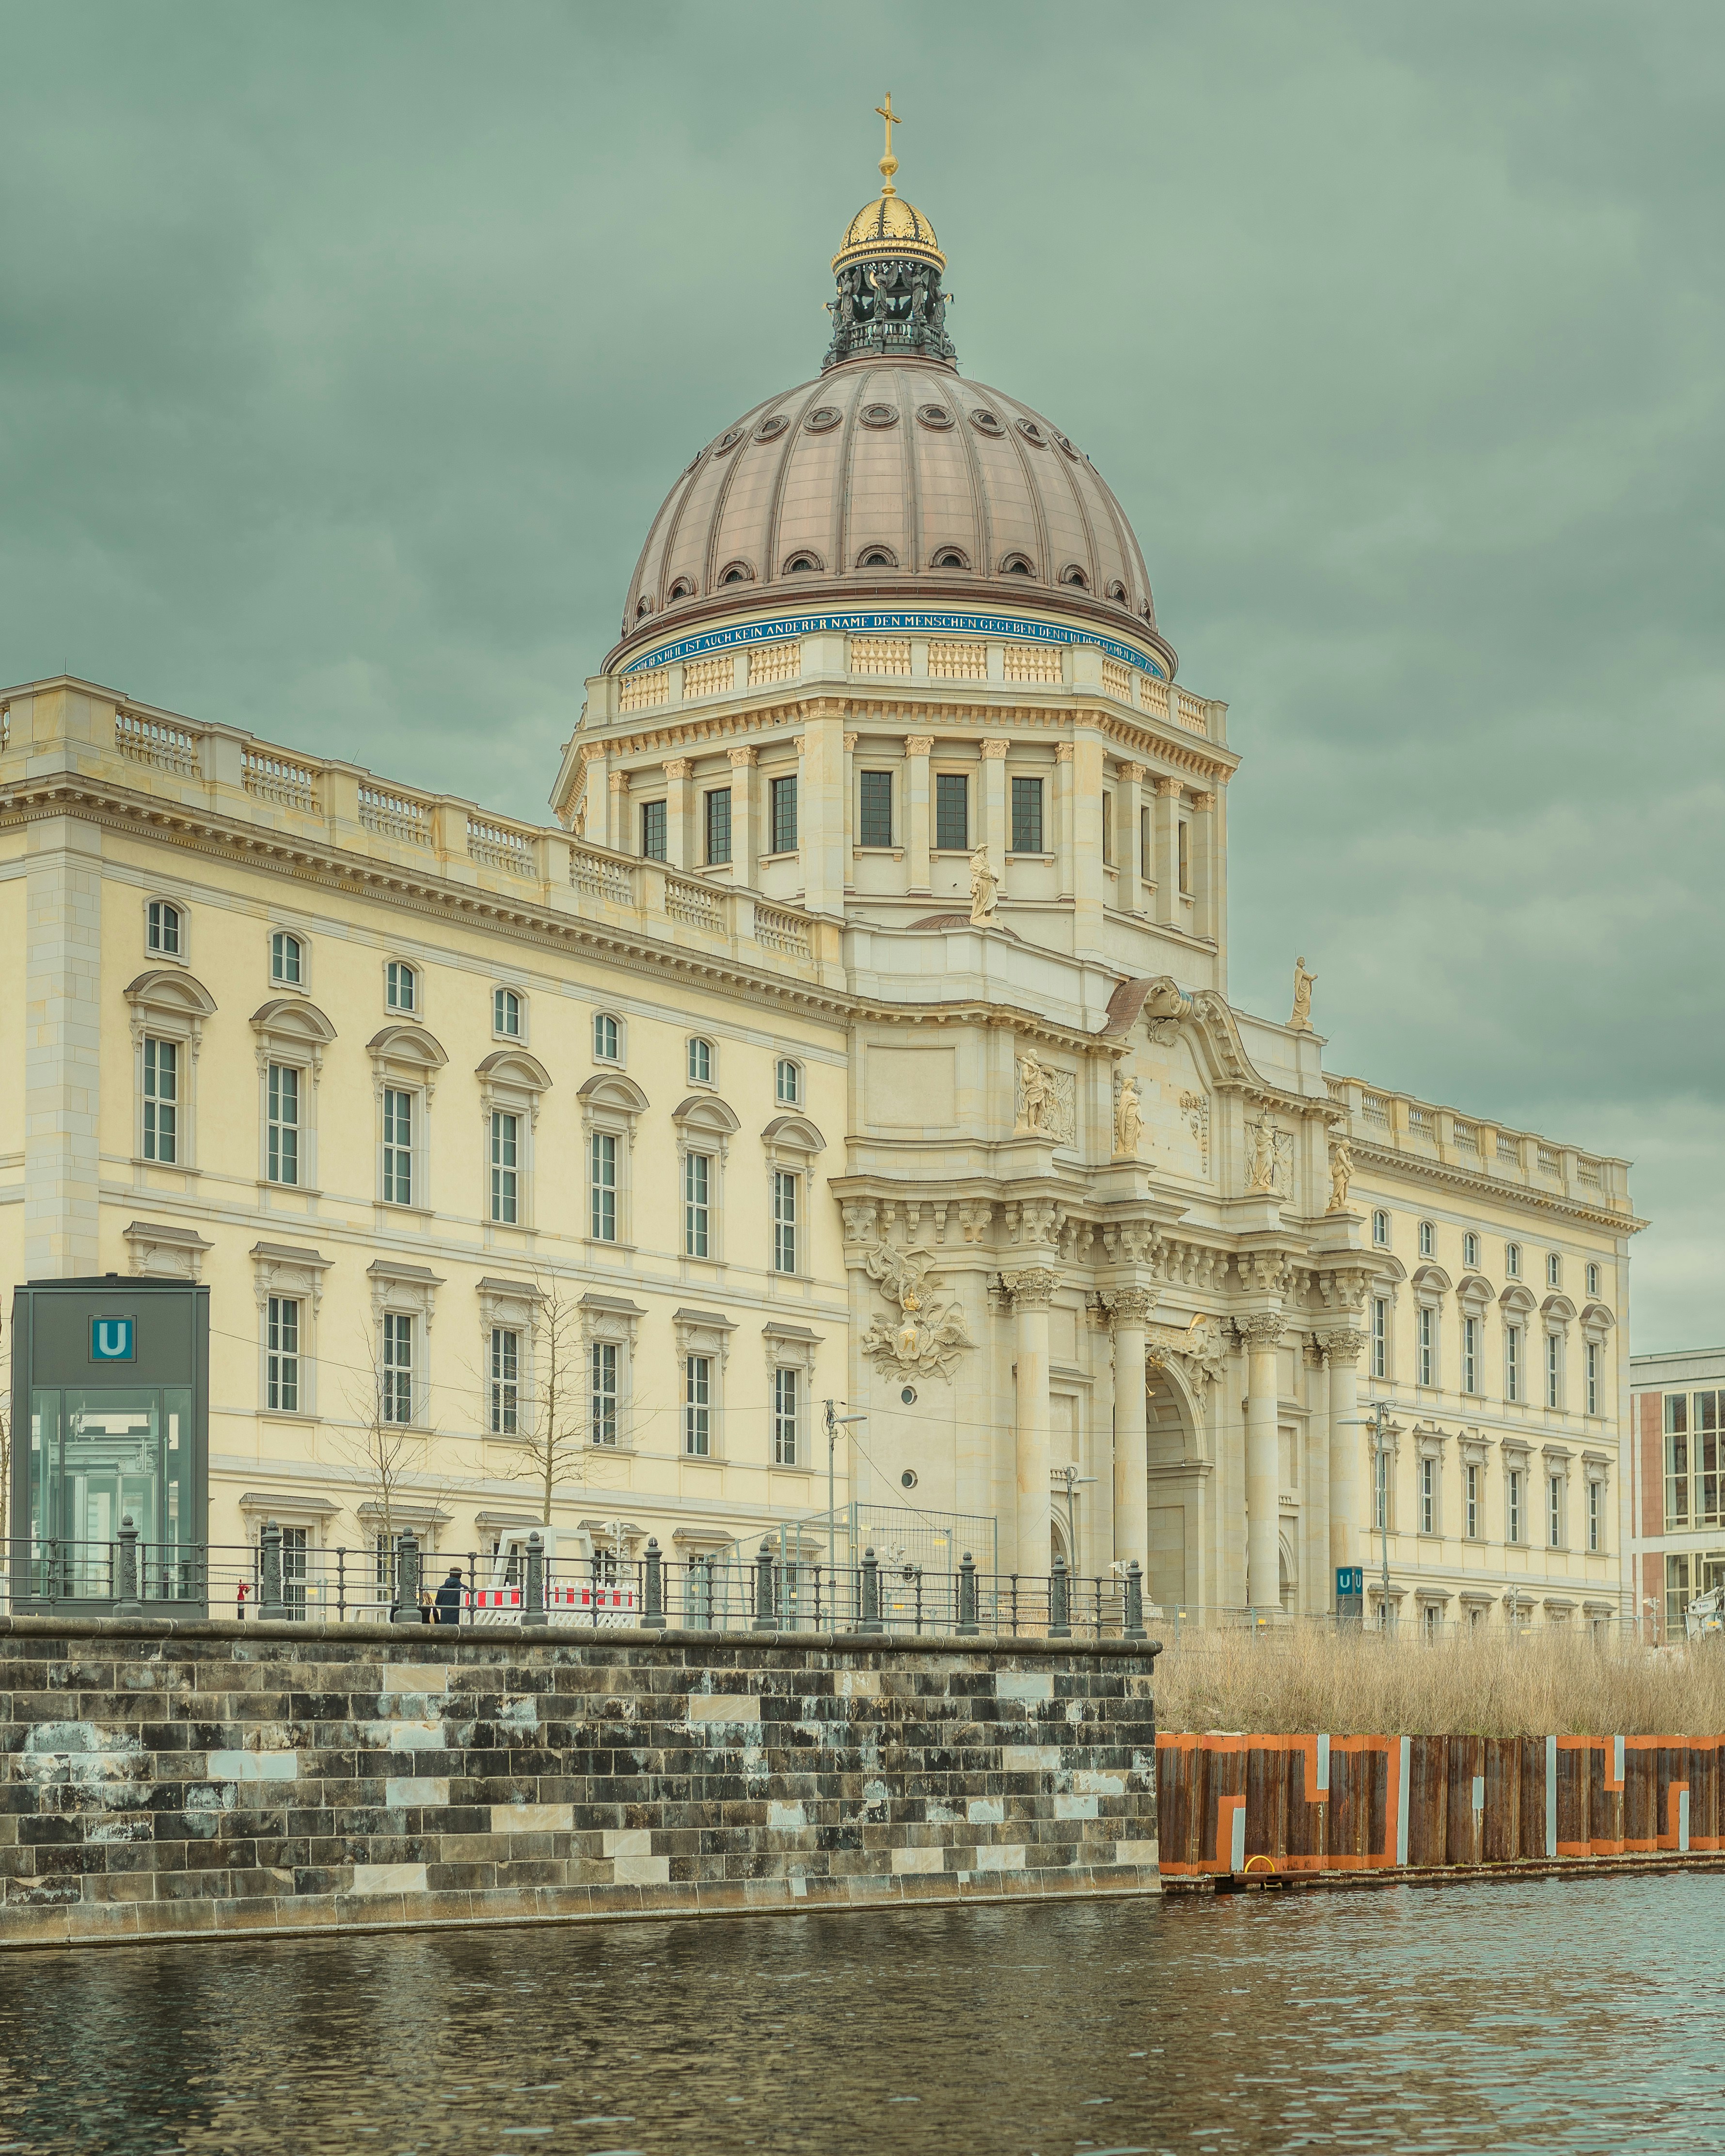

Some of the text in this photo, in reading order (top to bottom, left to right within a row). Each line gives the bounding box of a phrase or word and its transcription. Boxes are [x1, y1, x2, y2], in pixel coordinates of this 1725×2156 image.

[686, 640, 701, 652] IST
[704, 630, 731, 647] AUCH
[735, 627, 762, 641] KEIN
[767, 618, 826, 635] ANDERER
[832, 617, 869, 628] NAME
[874, 616, 900, 626] DEN
[905, 616, 976, 628] MENSCHEN
[980, 619, 1035, 635] GEGEBEN
[1039, 626, 1067, 641] DENN
[1070, 632, 1079, 643] IN
[99, 1323, 126, 1355] U
[1340, 1574, 1350, 1588] U
[1356, 1574, 1361, 1588] U
[1317, 1804, 1323, 1817] 3
